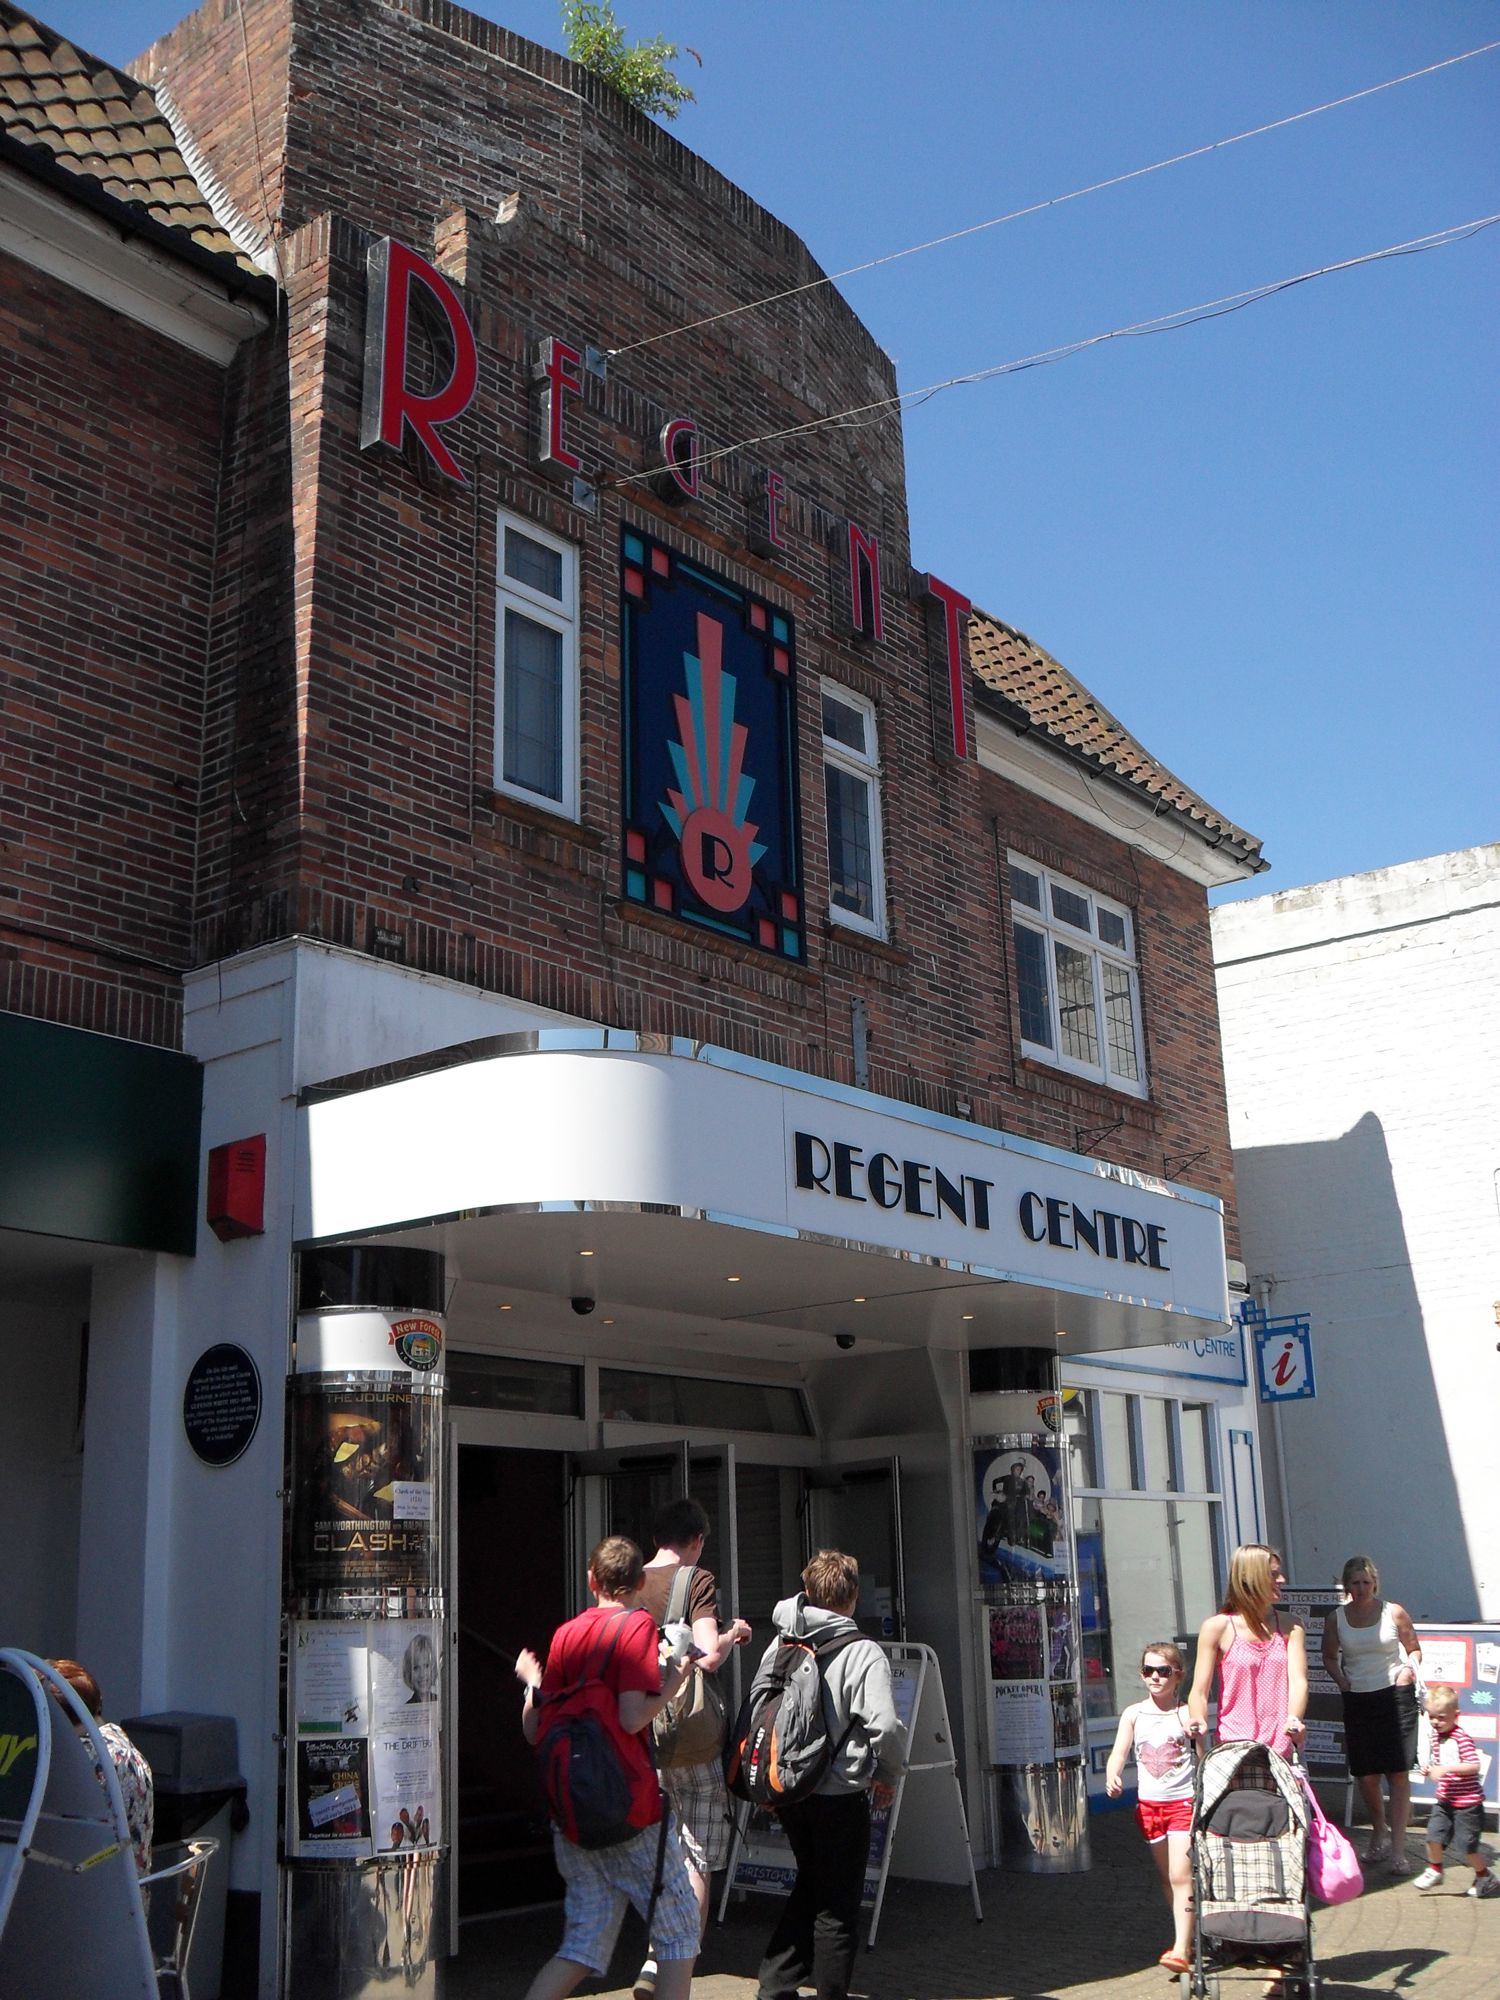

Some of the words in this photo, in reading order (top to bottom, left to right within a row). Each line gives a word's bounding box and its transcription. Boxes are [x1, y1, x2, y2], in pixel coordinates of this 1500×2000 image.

[701, 831, 735, 889] R
[795, 1131, 995, 1230] REGENT
[1019, 1190, 1171, 1271] CENTRE
[395, 1321, 417, 1335] New
[355, 1392, 420, 1404] JOURNEY
[314, 1520, 332, 1532] SAM
[333, 1519, 391, 1531] WORTHINGTON
[313, 1531, 407, 1551] CLASH
[1291, 1607, 1308, 1615] FOR
[384, 1741, 401, 1751] THE
[332, 1771, 360, 1781] CHINA
[749, 1765, 758, 1786] TAKE
